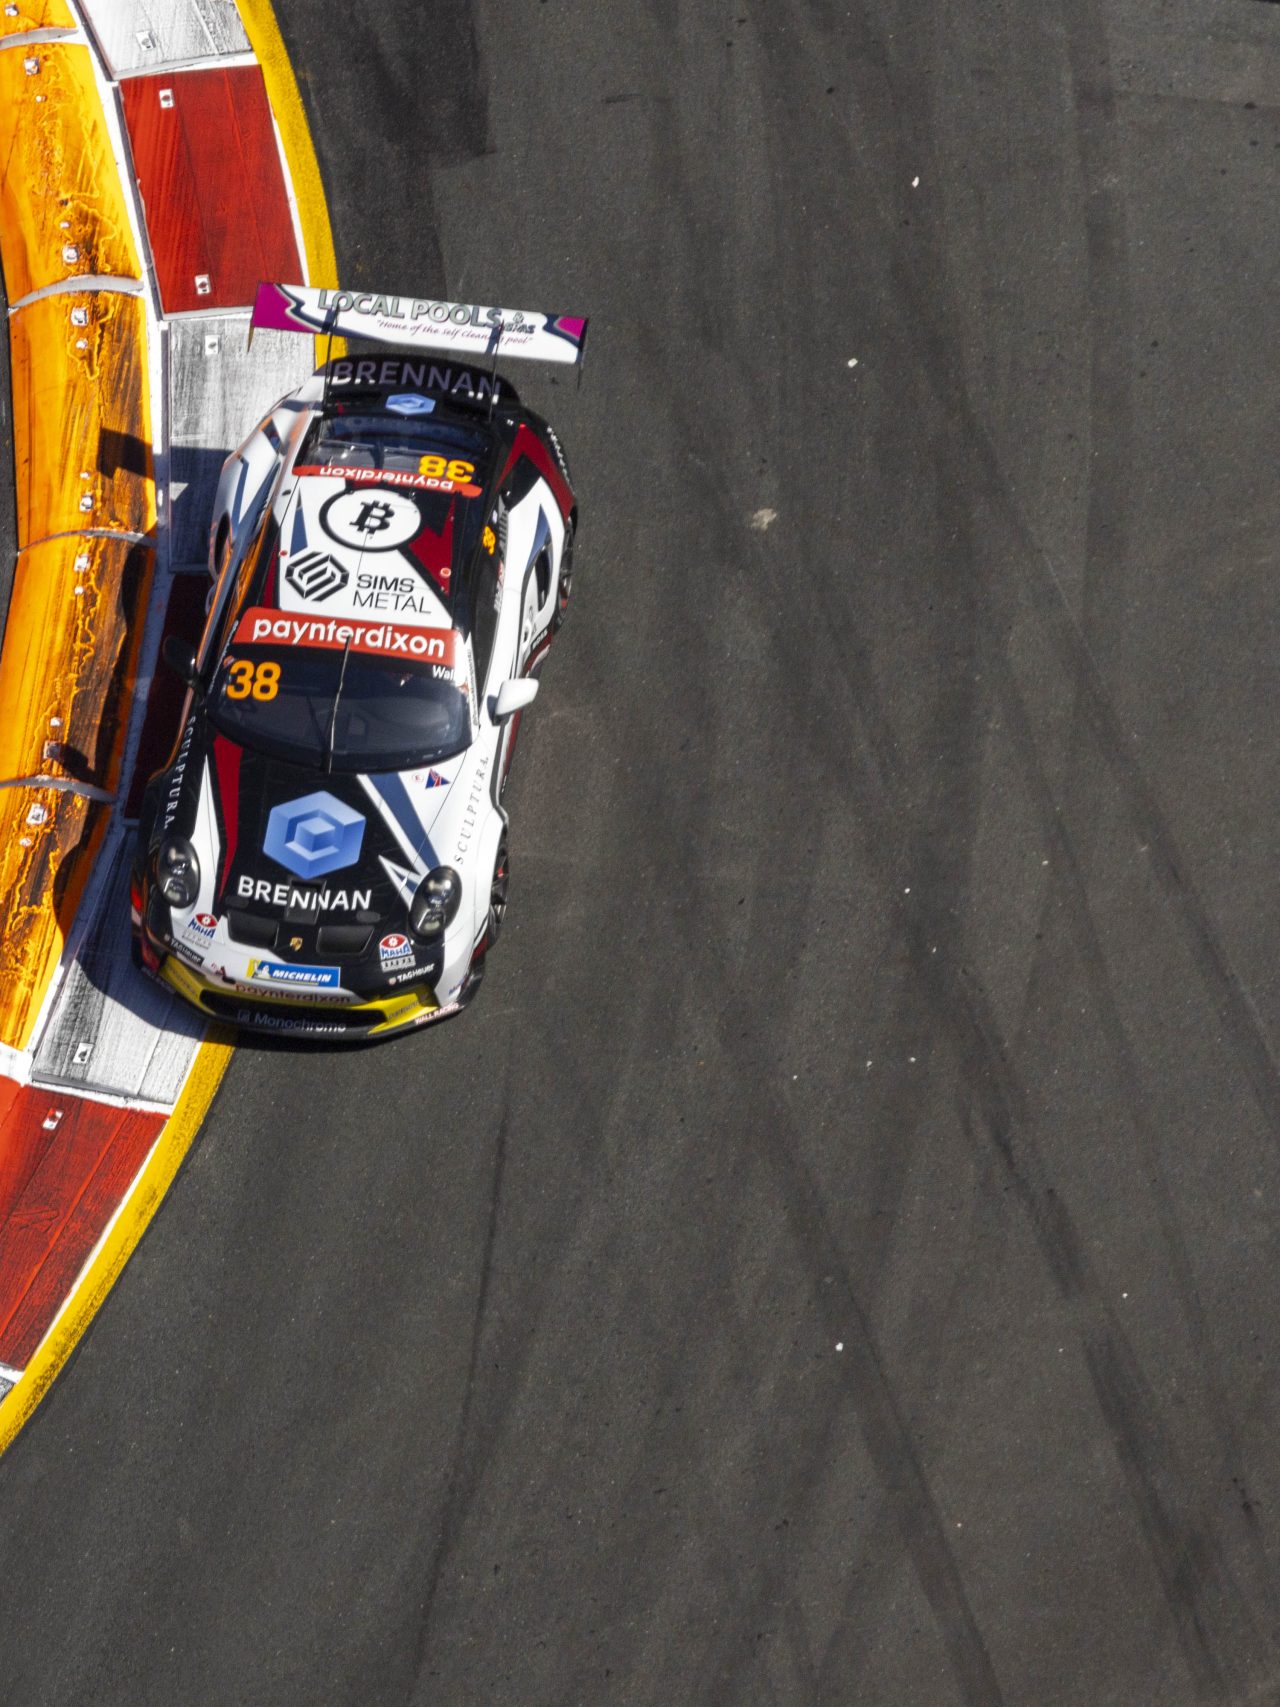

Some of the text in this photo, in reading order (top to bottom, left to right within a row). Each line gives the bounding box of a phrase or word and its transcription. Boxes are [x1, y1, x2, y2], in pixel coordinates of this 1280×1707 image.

[318, 290, 503, 330] LOCAL POOLS
[409, 323, 422, 337] of
[423, 323, 439, 335] the
[331, 360, 502, 405] BRENNAN
[320, 466, 454, 491] paynterdixon
[419, 454, 475, 484] 38
[356, 573, 415, 593] SIMS
[352, 590, 431, 615] METAL
[252, 618, 446, 659] paynterdixon
[226, 660, 282, 702] 38
[237, 874, 372, 912] BRENNAN
[188, 917, 217, 939] MAHA
[381, 943, 411, 960] MAHA
[273, 969, 332, 984] MICHELIN
[235, 983, 351, 1003] paynterdixon
[255, 1012, 347, 1032] Monochrome
